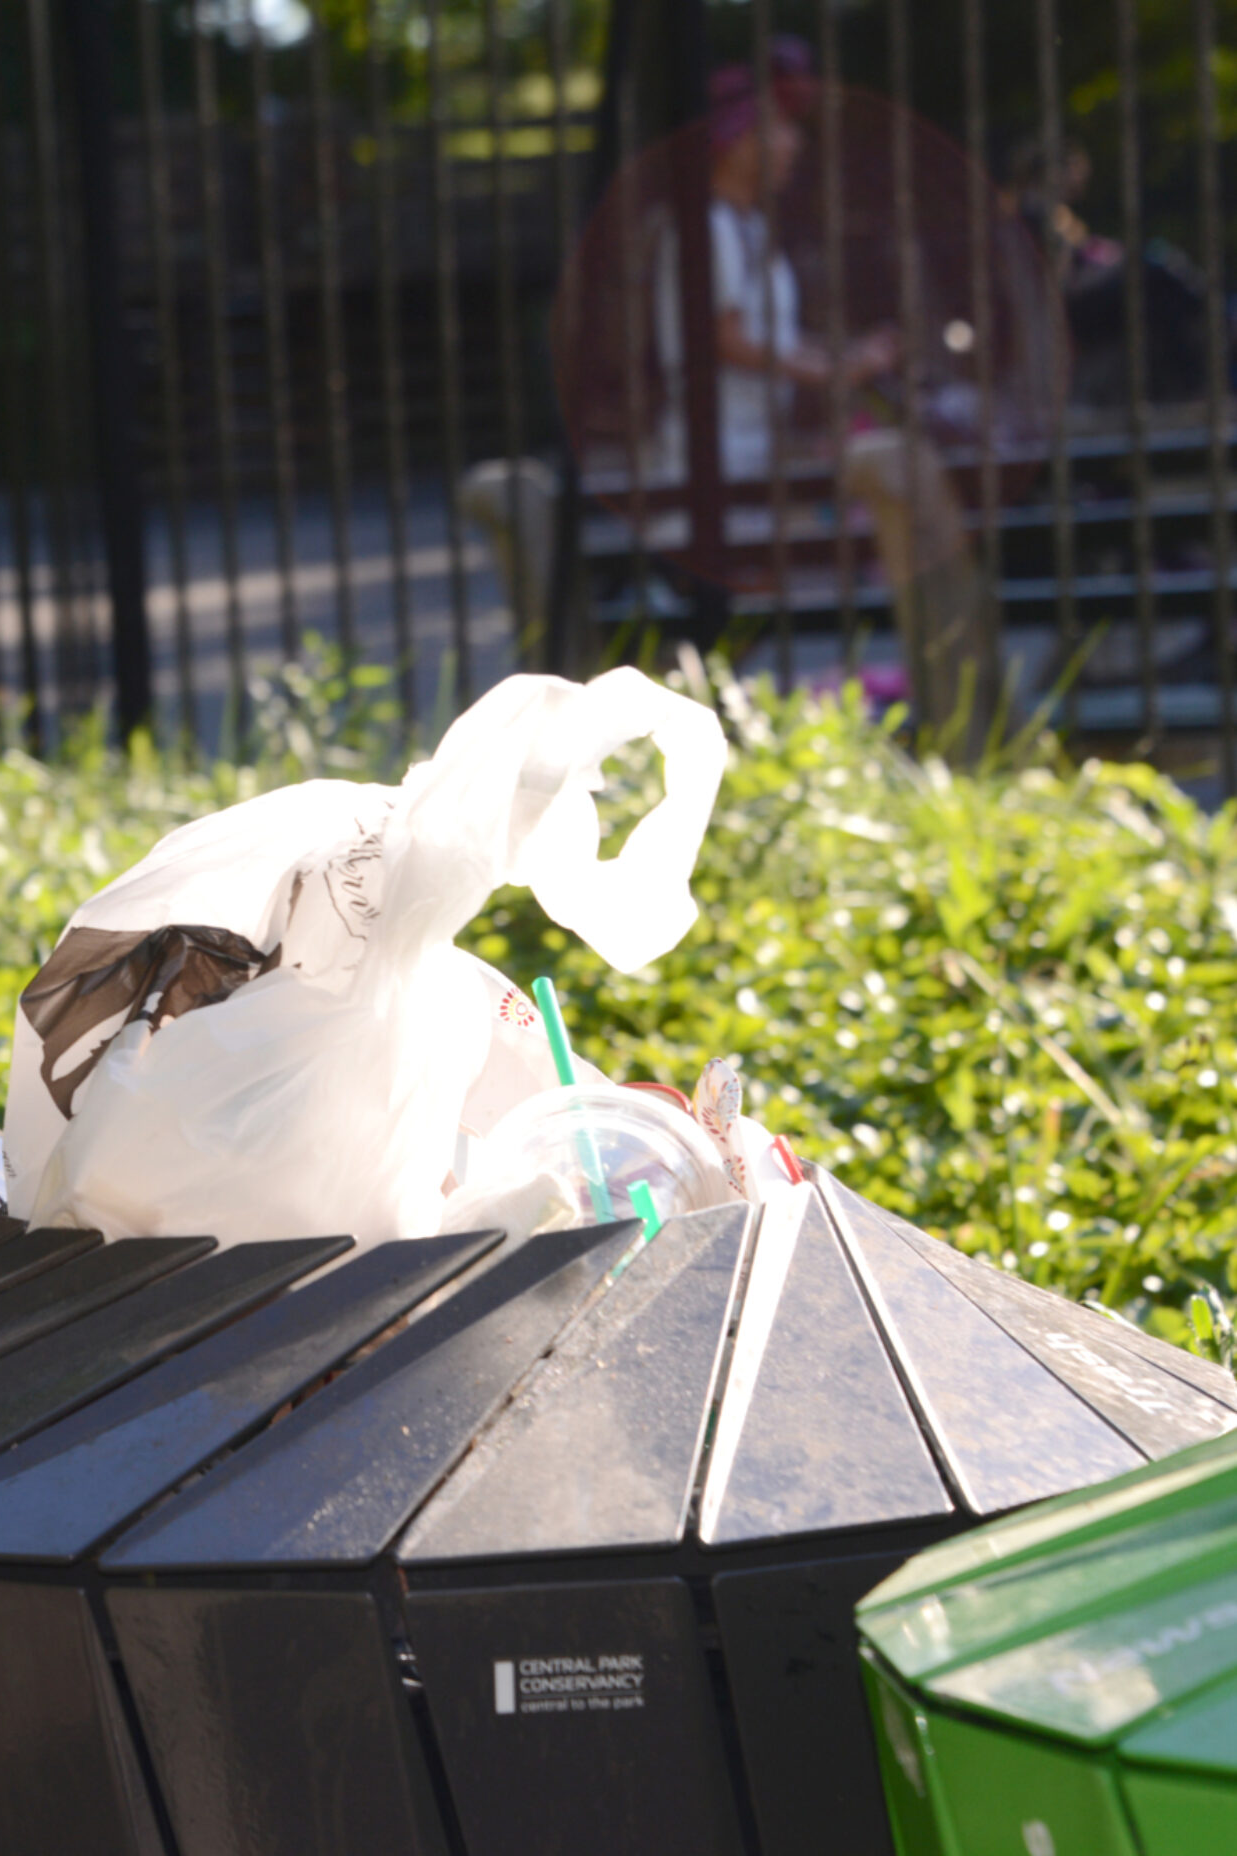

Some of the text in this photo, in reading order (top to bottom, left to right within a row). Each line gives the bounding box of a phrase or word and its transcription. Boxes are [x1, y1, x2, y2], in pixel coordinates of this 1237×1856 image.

[519, 1655, 643, 1675] CENTRAL PARK
[519, 1673, 644, 1693] CONSERVANCY
[520, 1696, 644, 1714] central to the park
